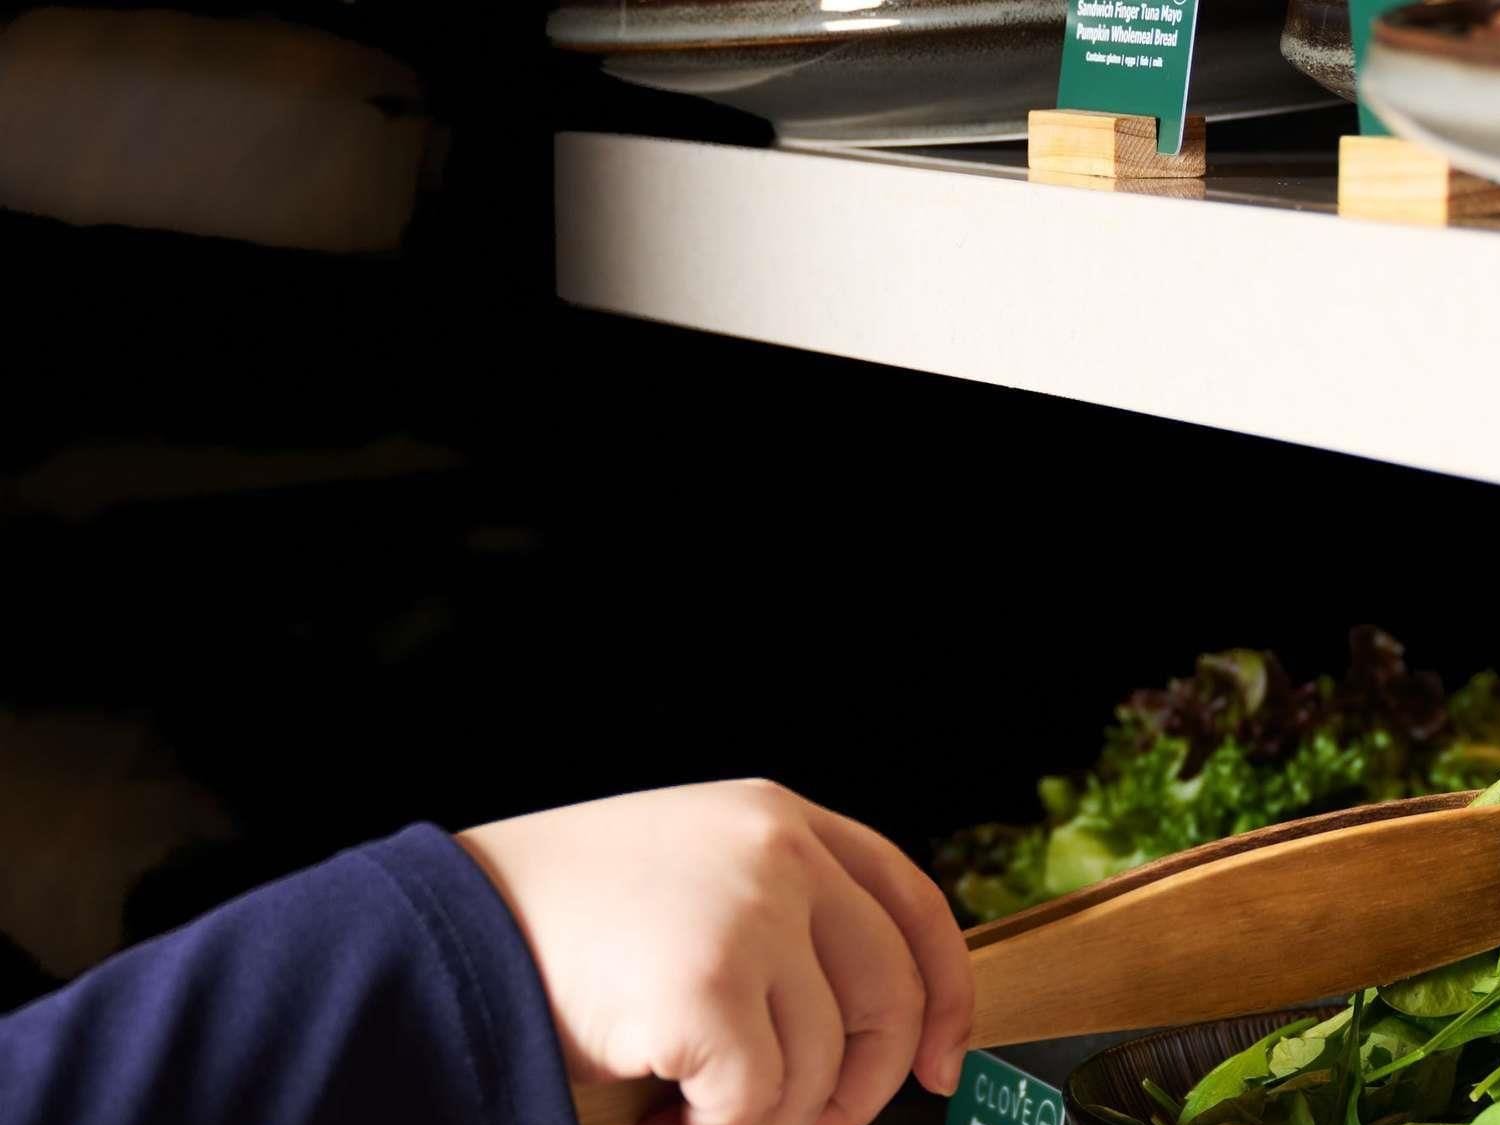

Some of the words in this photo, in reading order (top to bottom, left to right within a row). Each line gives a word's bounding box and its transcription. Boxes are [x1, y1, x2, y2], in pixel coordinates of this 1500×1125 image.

[1077, 0, 1113, 18] Sandwich
[1115, 1, 1140, 22] Finger
[1141, 3, 1159, 20] Tuna
[1161, 5, 1182, 26] Mayo
[1076, 23, 1110, 44] Pumpkin
[1111, 26, 1153, 45] Wholemeal
[1154, 30, 1178, 47] Bread
